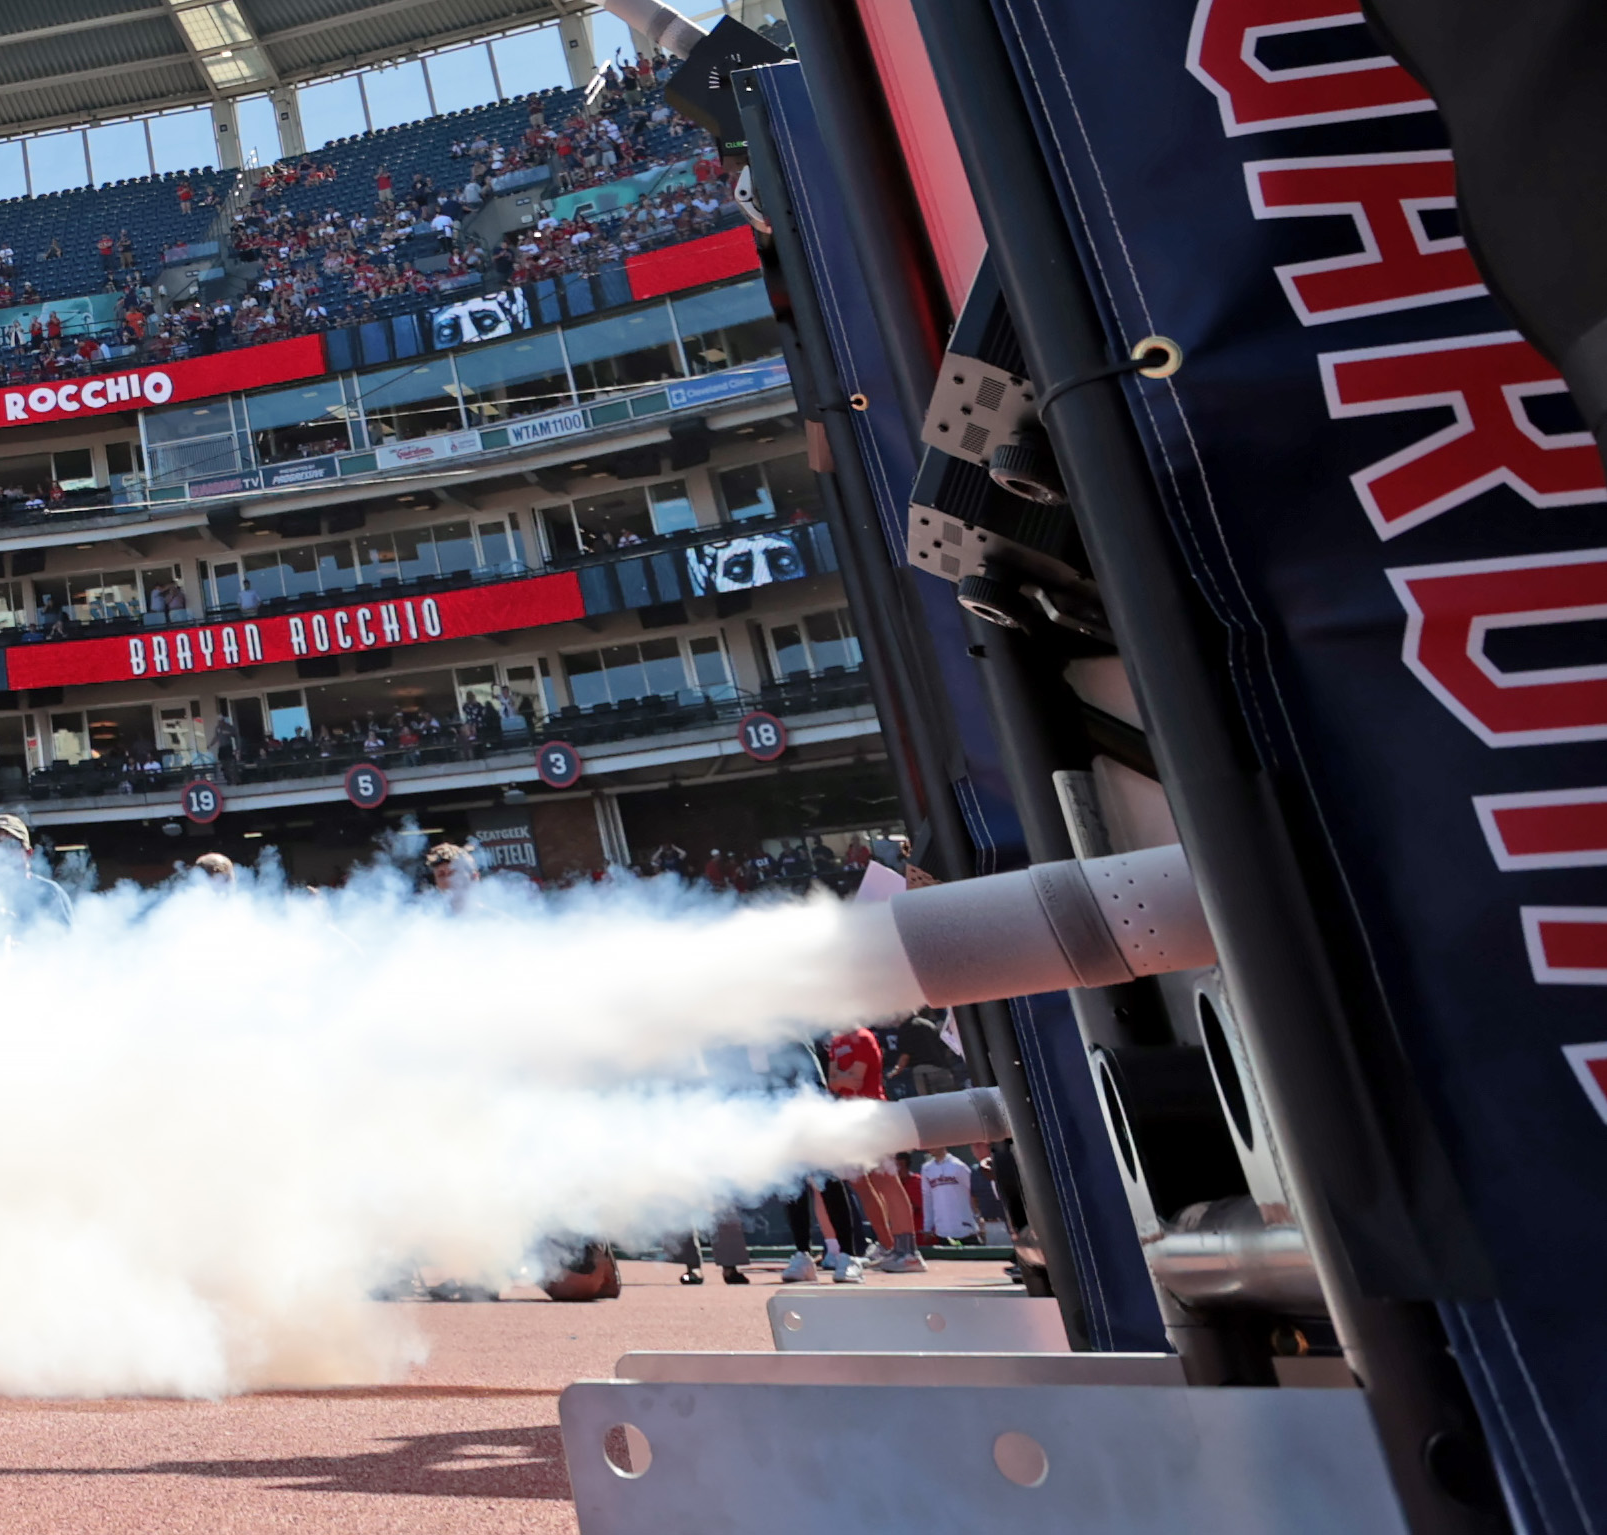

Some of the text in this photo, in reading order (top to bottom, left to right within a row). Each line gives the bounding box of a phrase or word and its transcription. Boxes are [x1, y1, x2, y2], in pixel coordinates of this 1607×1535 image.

[4, 371, 174, 421] ROCCHIO
[243, 476, 260, 490] TV
[128, 597, 443, 676] BRAYAN ROCCHIO
[746, 722, 778, 749] 18
[548, 752, 568, 776] 3
[356, 774, 375, 797] 5
[188, 790, 215, 813] 19
[486, 843, 537, 868] NFIELD
